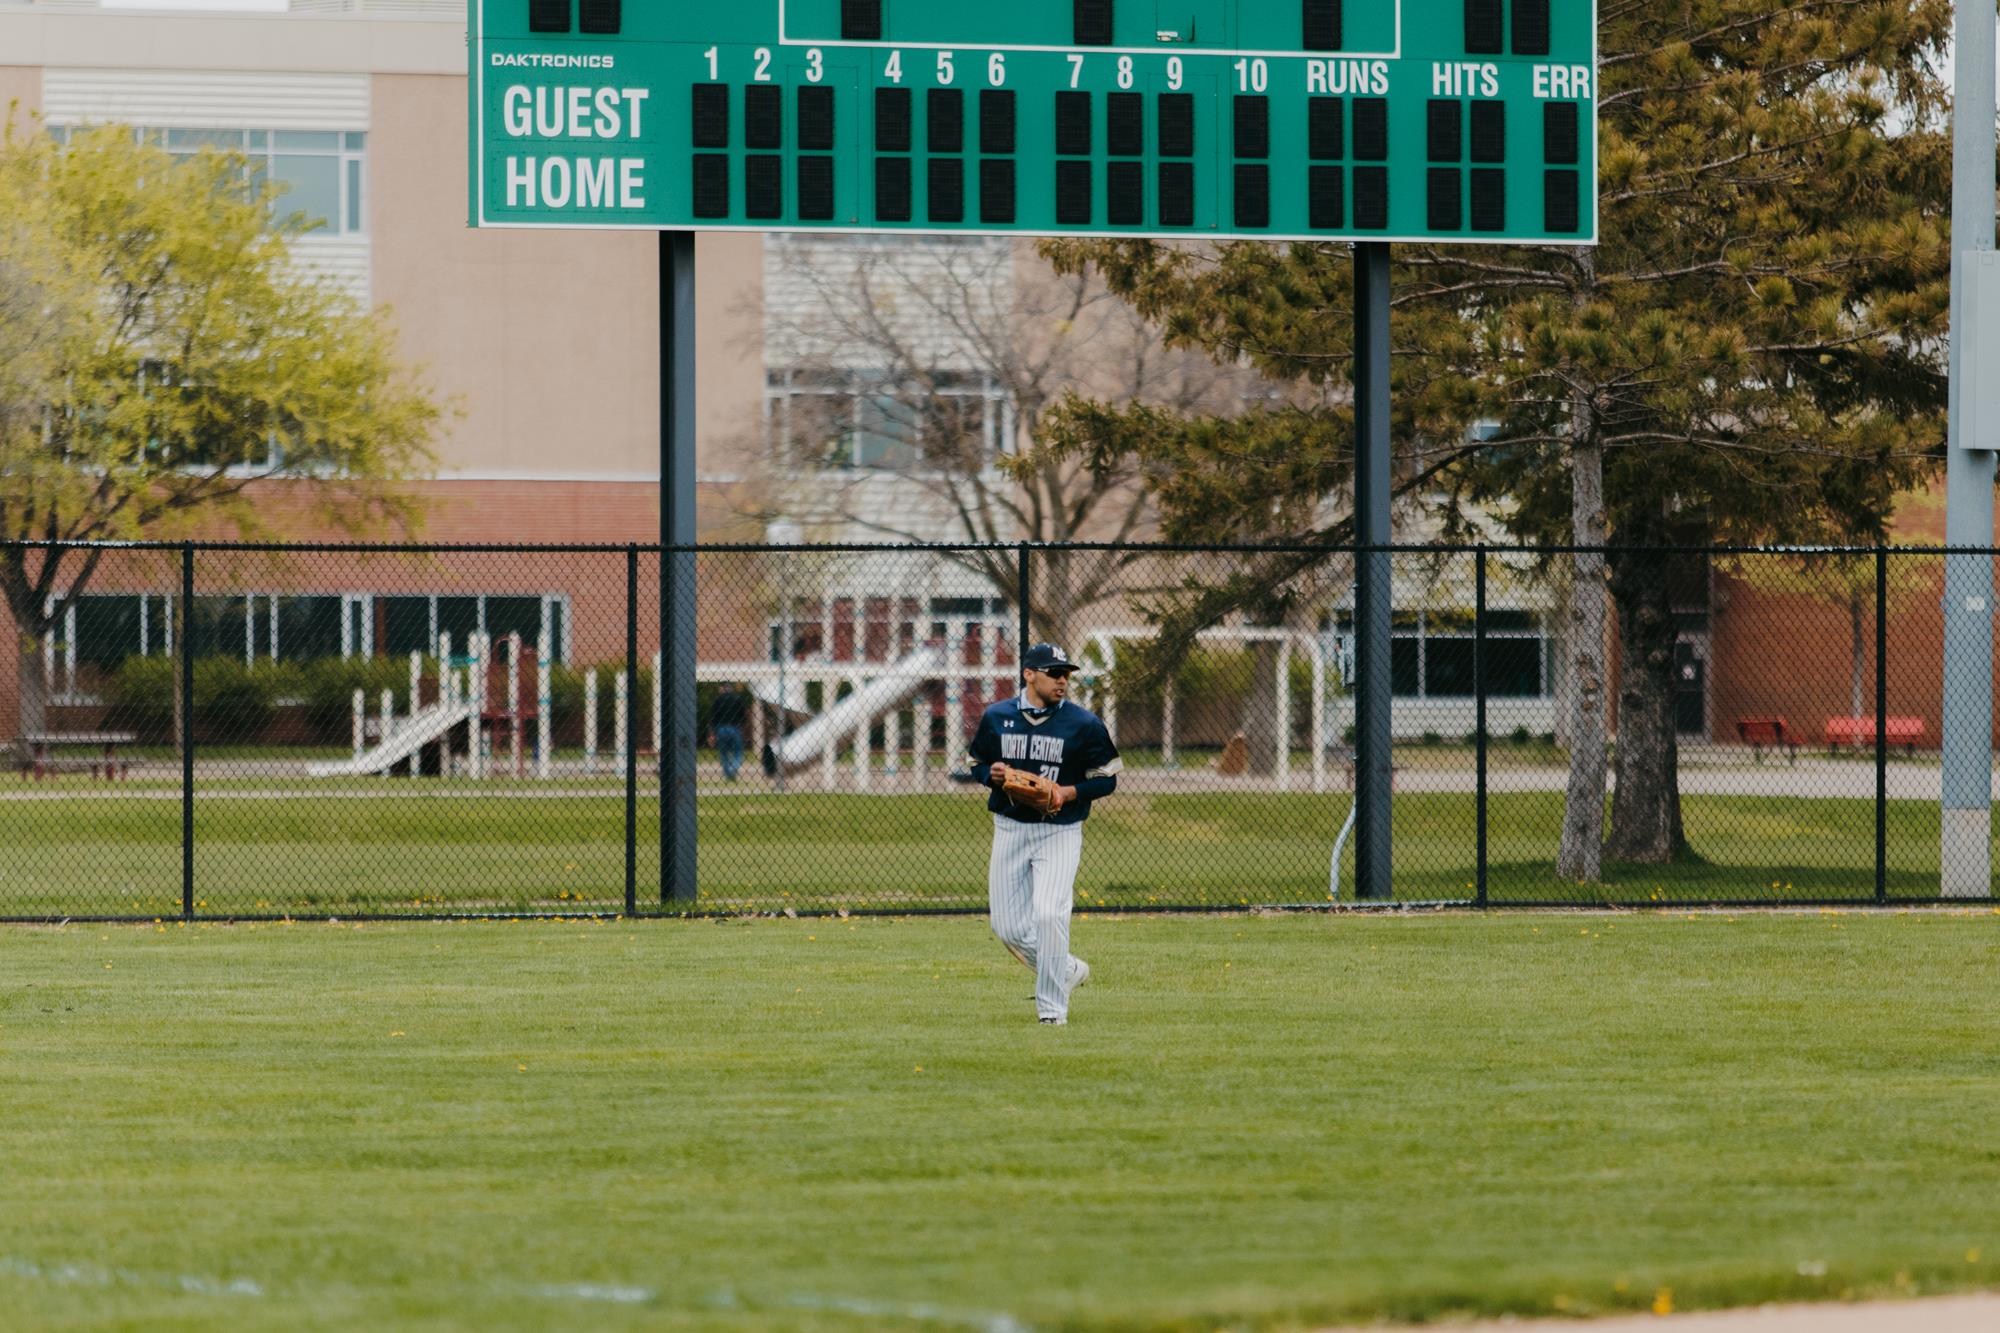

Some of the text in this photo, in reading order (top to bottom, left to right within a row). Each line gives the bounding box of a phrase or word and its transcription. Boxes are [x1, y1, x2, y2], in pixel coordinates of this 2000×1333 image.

[491, 53, 614, 69] DAKTRONICS
[703, 46, 1591, 99] 1 2 3 4 5 6 7 8 9 10 RUNS HITS ERR
[503, 85, 649, 139] GUEST
[506, 156, 645, 209] HOME
[1001, 733, 1065, 764] NORTH CENTRAL
